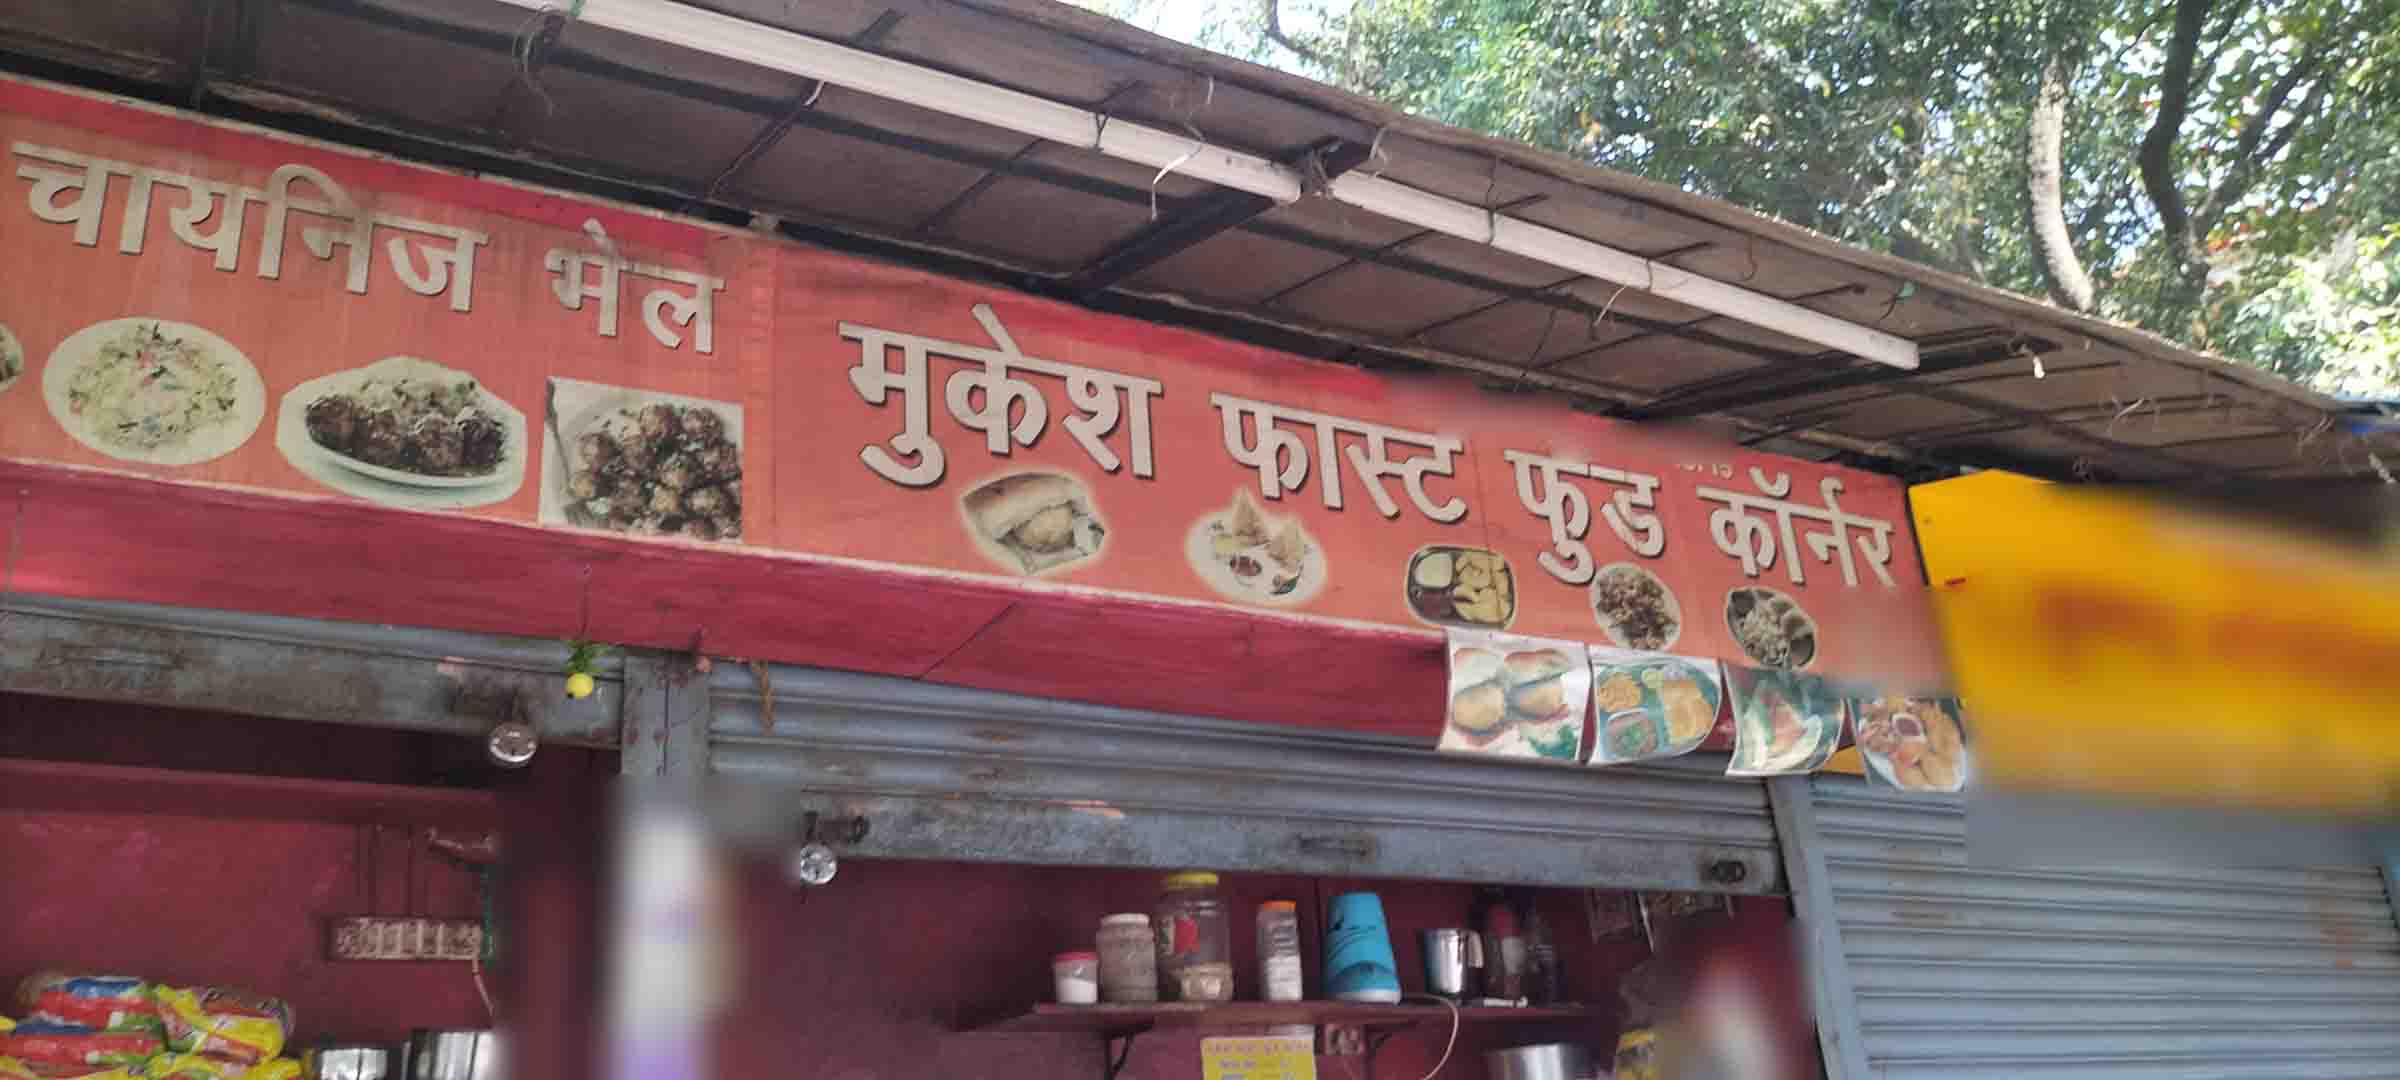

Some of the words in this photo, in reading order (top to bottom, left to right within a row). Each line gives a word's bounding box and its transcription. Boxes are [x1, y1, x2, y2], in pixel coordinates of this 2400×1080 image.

[13, 142, 489, 313] चायनिज
[544, 218, 726, 354] भेल
[838, 303, 1163, 487] मुकेश
[1211, 391, 1468, 523] फास्ट
[1503, 449, 1666, 585] फुड
[1696, 467, 1895, 587] कॉर्नर
